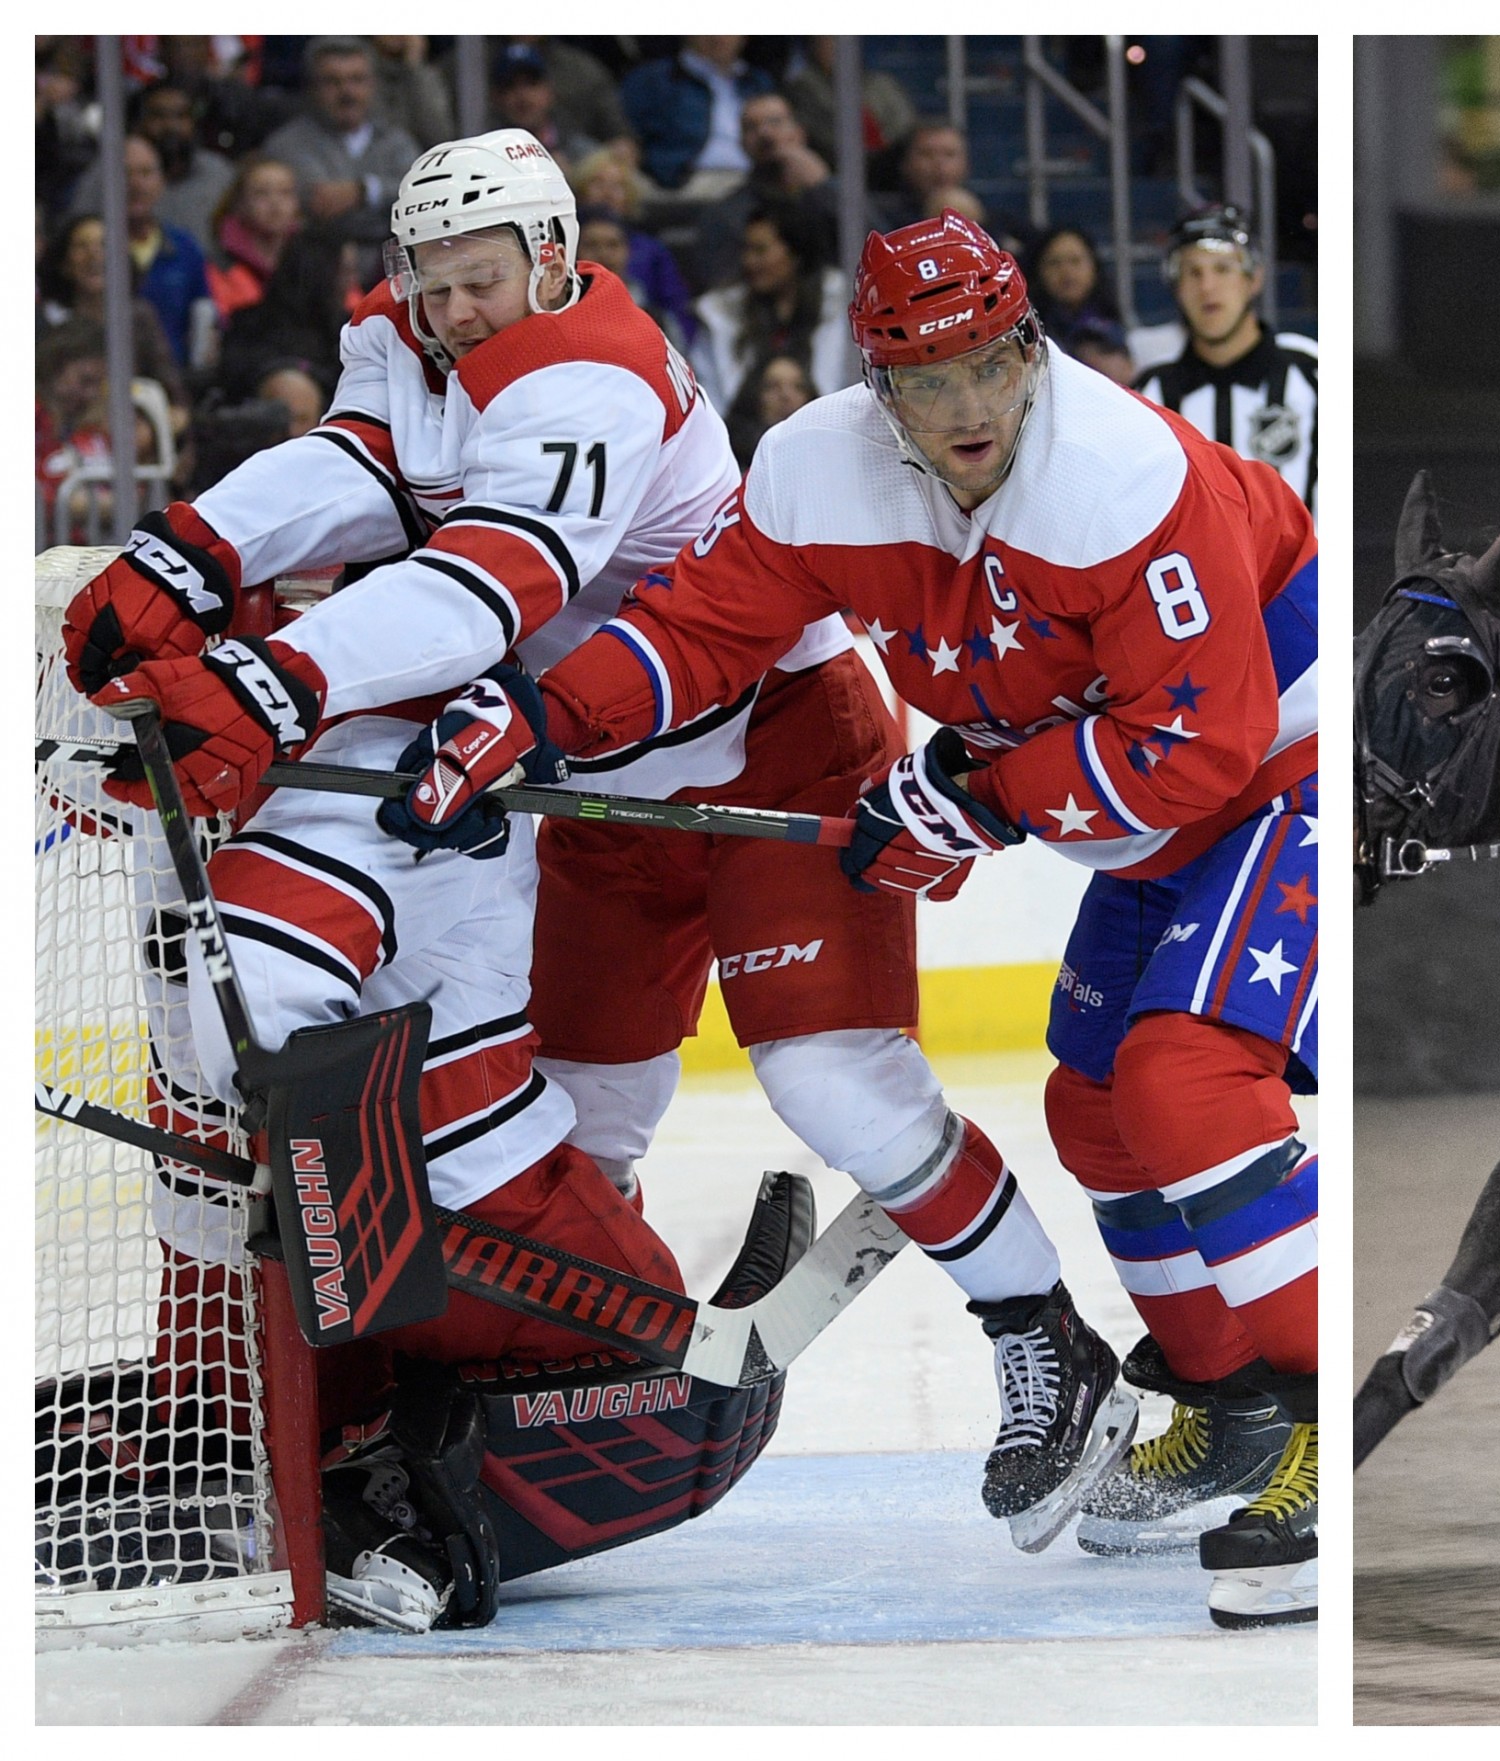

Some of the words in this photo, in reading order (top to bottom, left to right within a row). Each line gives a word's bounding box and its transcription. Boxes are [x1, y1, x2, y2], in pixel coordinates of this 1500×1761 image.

[504, 144, 551, 163] CANE
[404, 198, 450, 216] CCM
[916, 258, 940, 281] 8
[917, 307, 975, 336] CCM
[540, 440, 608, 518] 71
[983, 553, 1019, 613] C
[1144, 551, 1212, 643] 8
[207, 639, 307, 745] CCM
[609, 808, 654, 820] TRIGGER
[188, 895, 232, 983] CCM
[720, 938, 824, 980] CCM
[289, 1138, 351, 1331] VAUGHN
[512, 1373, 692, 1429] VAUGHN
